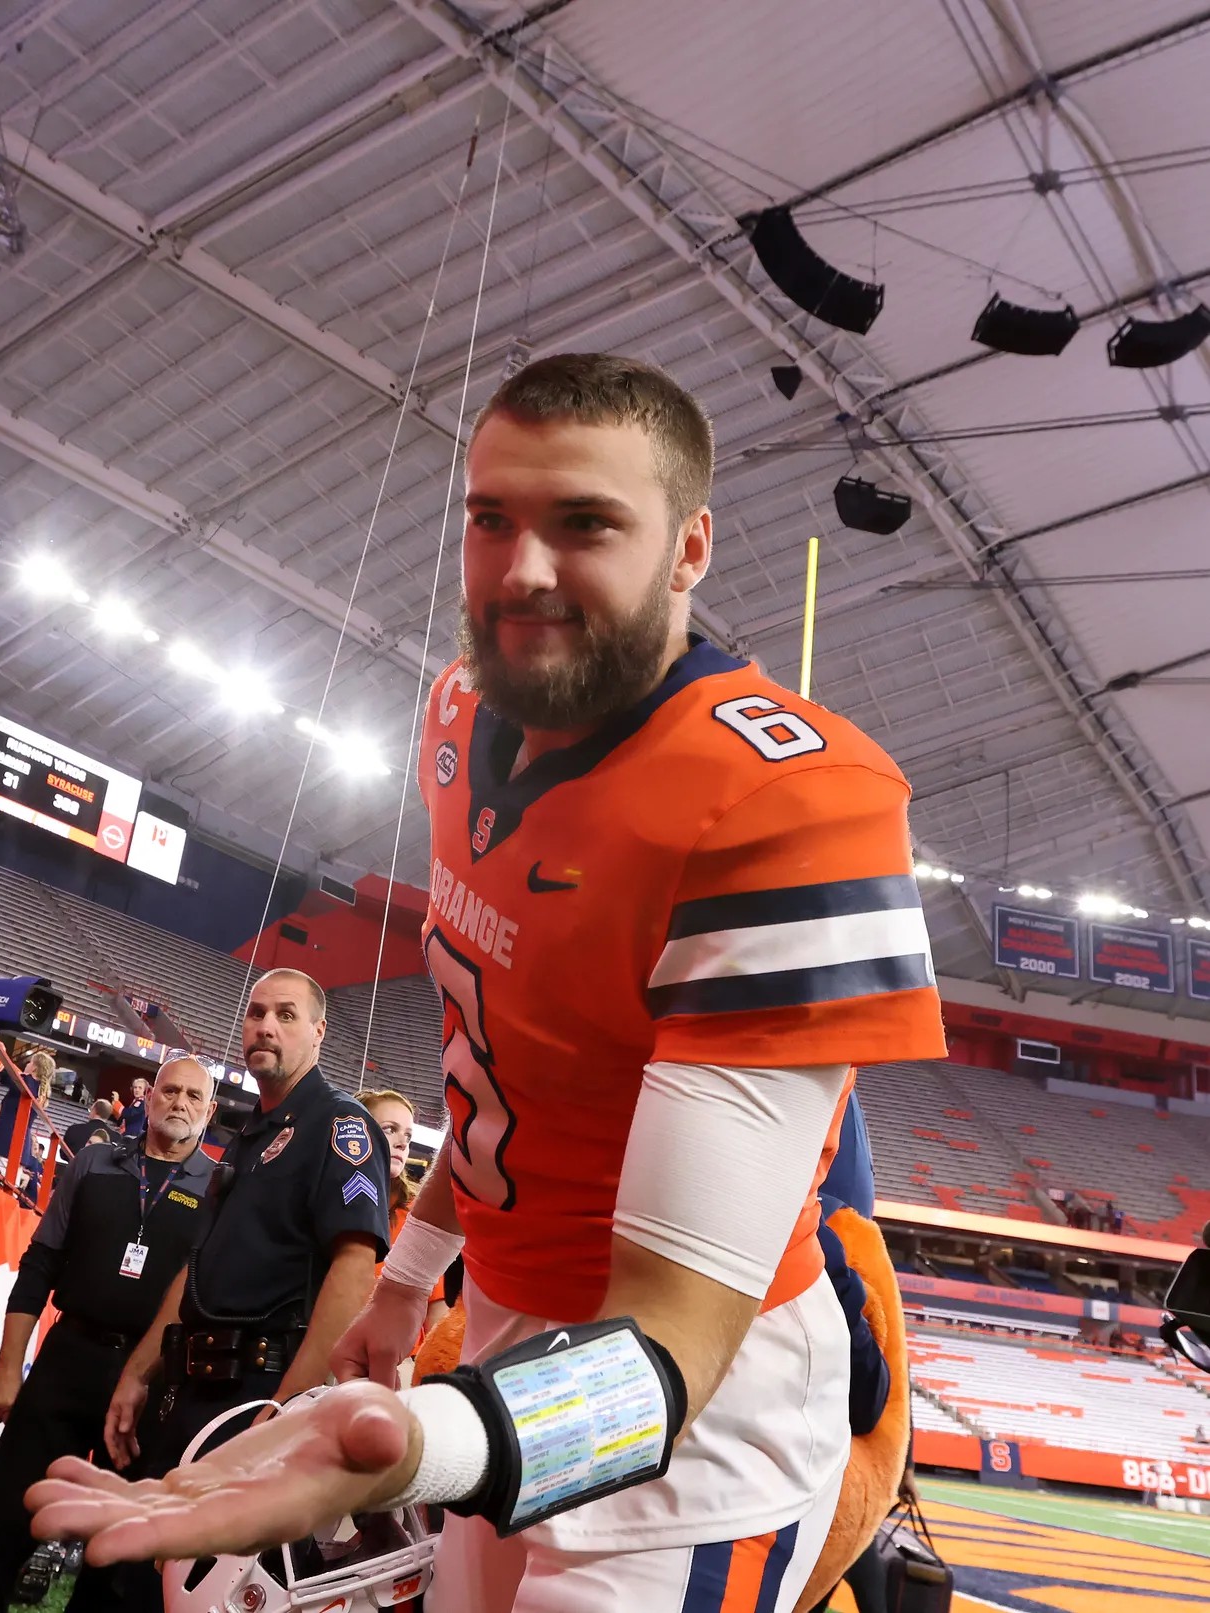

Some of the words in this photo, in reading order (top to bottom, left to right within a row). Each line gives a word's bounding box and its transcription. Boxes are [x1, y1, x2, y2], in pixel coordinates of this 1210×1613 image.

[439, 666, 474, 727] C
[712, 695, 827, 763] 6
[438, 750, 456, 773] ACC
[47, 773, 95, 803] SYRACUSE
[472, 806, 496, 853] S
[431, 858, 519, 970] ORANGE
[1020, 957, 1056, 975] 2000
[1114, 972, 1151, 990] 2002
[87, 1022, 125, 1048] 0:00
[340, 1123, 363, 1132] CAMPUS
[347, 1140, 362, 1156] S
[990, 1441, 1012, 1472] S
